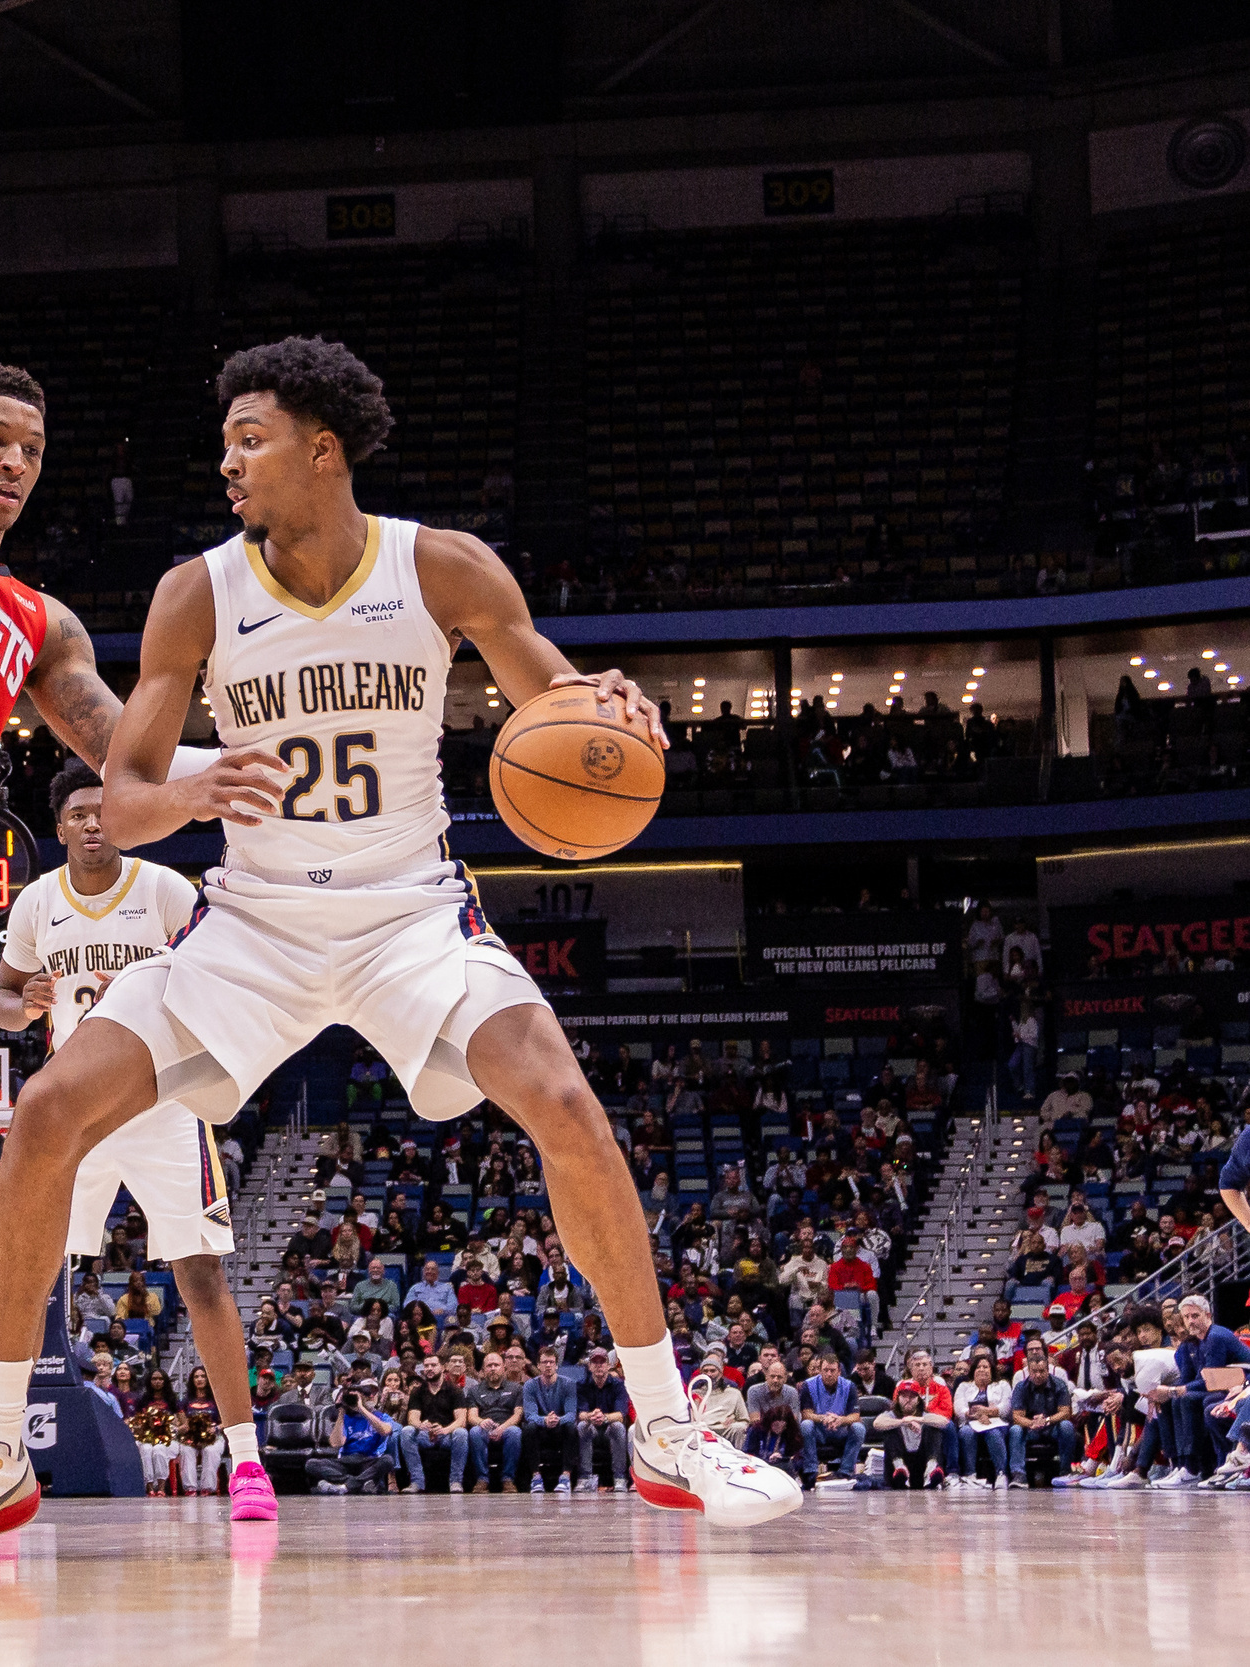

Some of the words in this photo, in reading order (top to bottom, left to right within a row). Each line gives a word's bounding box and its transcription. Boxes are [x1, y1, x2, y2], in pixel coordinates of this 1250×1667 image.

[769, 179, 831, 207] 309
[330, 203, 394, 231] 308
[350, 599, 405, 617] NEWAGE
[365, 613, 394, 623] GRILLS
[225, 670, 287, 729] NEW
[298, 660, 427, 715] ORLEANS
[276, 729, 383, 823] 25
[535, 883, 595, 913] 107
[118, 908, 147, 916] NEWAGE
[1087, 916, 1250, 964] SEATGEE
[762, 946, 813, 960] OFFICIAL
[815, 945, 875, 958] TICKETING
[877, 943, 929, 957] PARTNER
[931, 943, 947, 955] OF
[47, 945, 80, 978] NEW
[774, 961, 796, 974] THE
[797, 960, 824, 974] NEW
[825, 959, 878, 973] ORLEANS
[880, 958, 937, 972] PELICANS
[558, 1015, 606, 1026] TICKETING
[607, 1015, 648, 1025] PARTNER
[649, 1014, 661, 1024] OF
[662, 1014, 679, 1024] THE
[680, 1013, 701, 1024] NEW
[702, 1012, 743, 1023] ORLEANS
[745, 1011, 789, 1022] PELICANS
[825, 1006, 900, 1023] SEATGEEK
[33, 1364, 66, 1375] ederal
[34, 1355, 66, 1366] eesler
[21, 1402, 58, 1450] G
